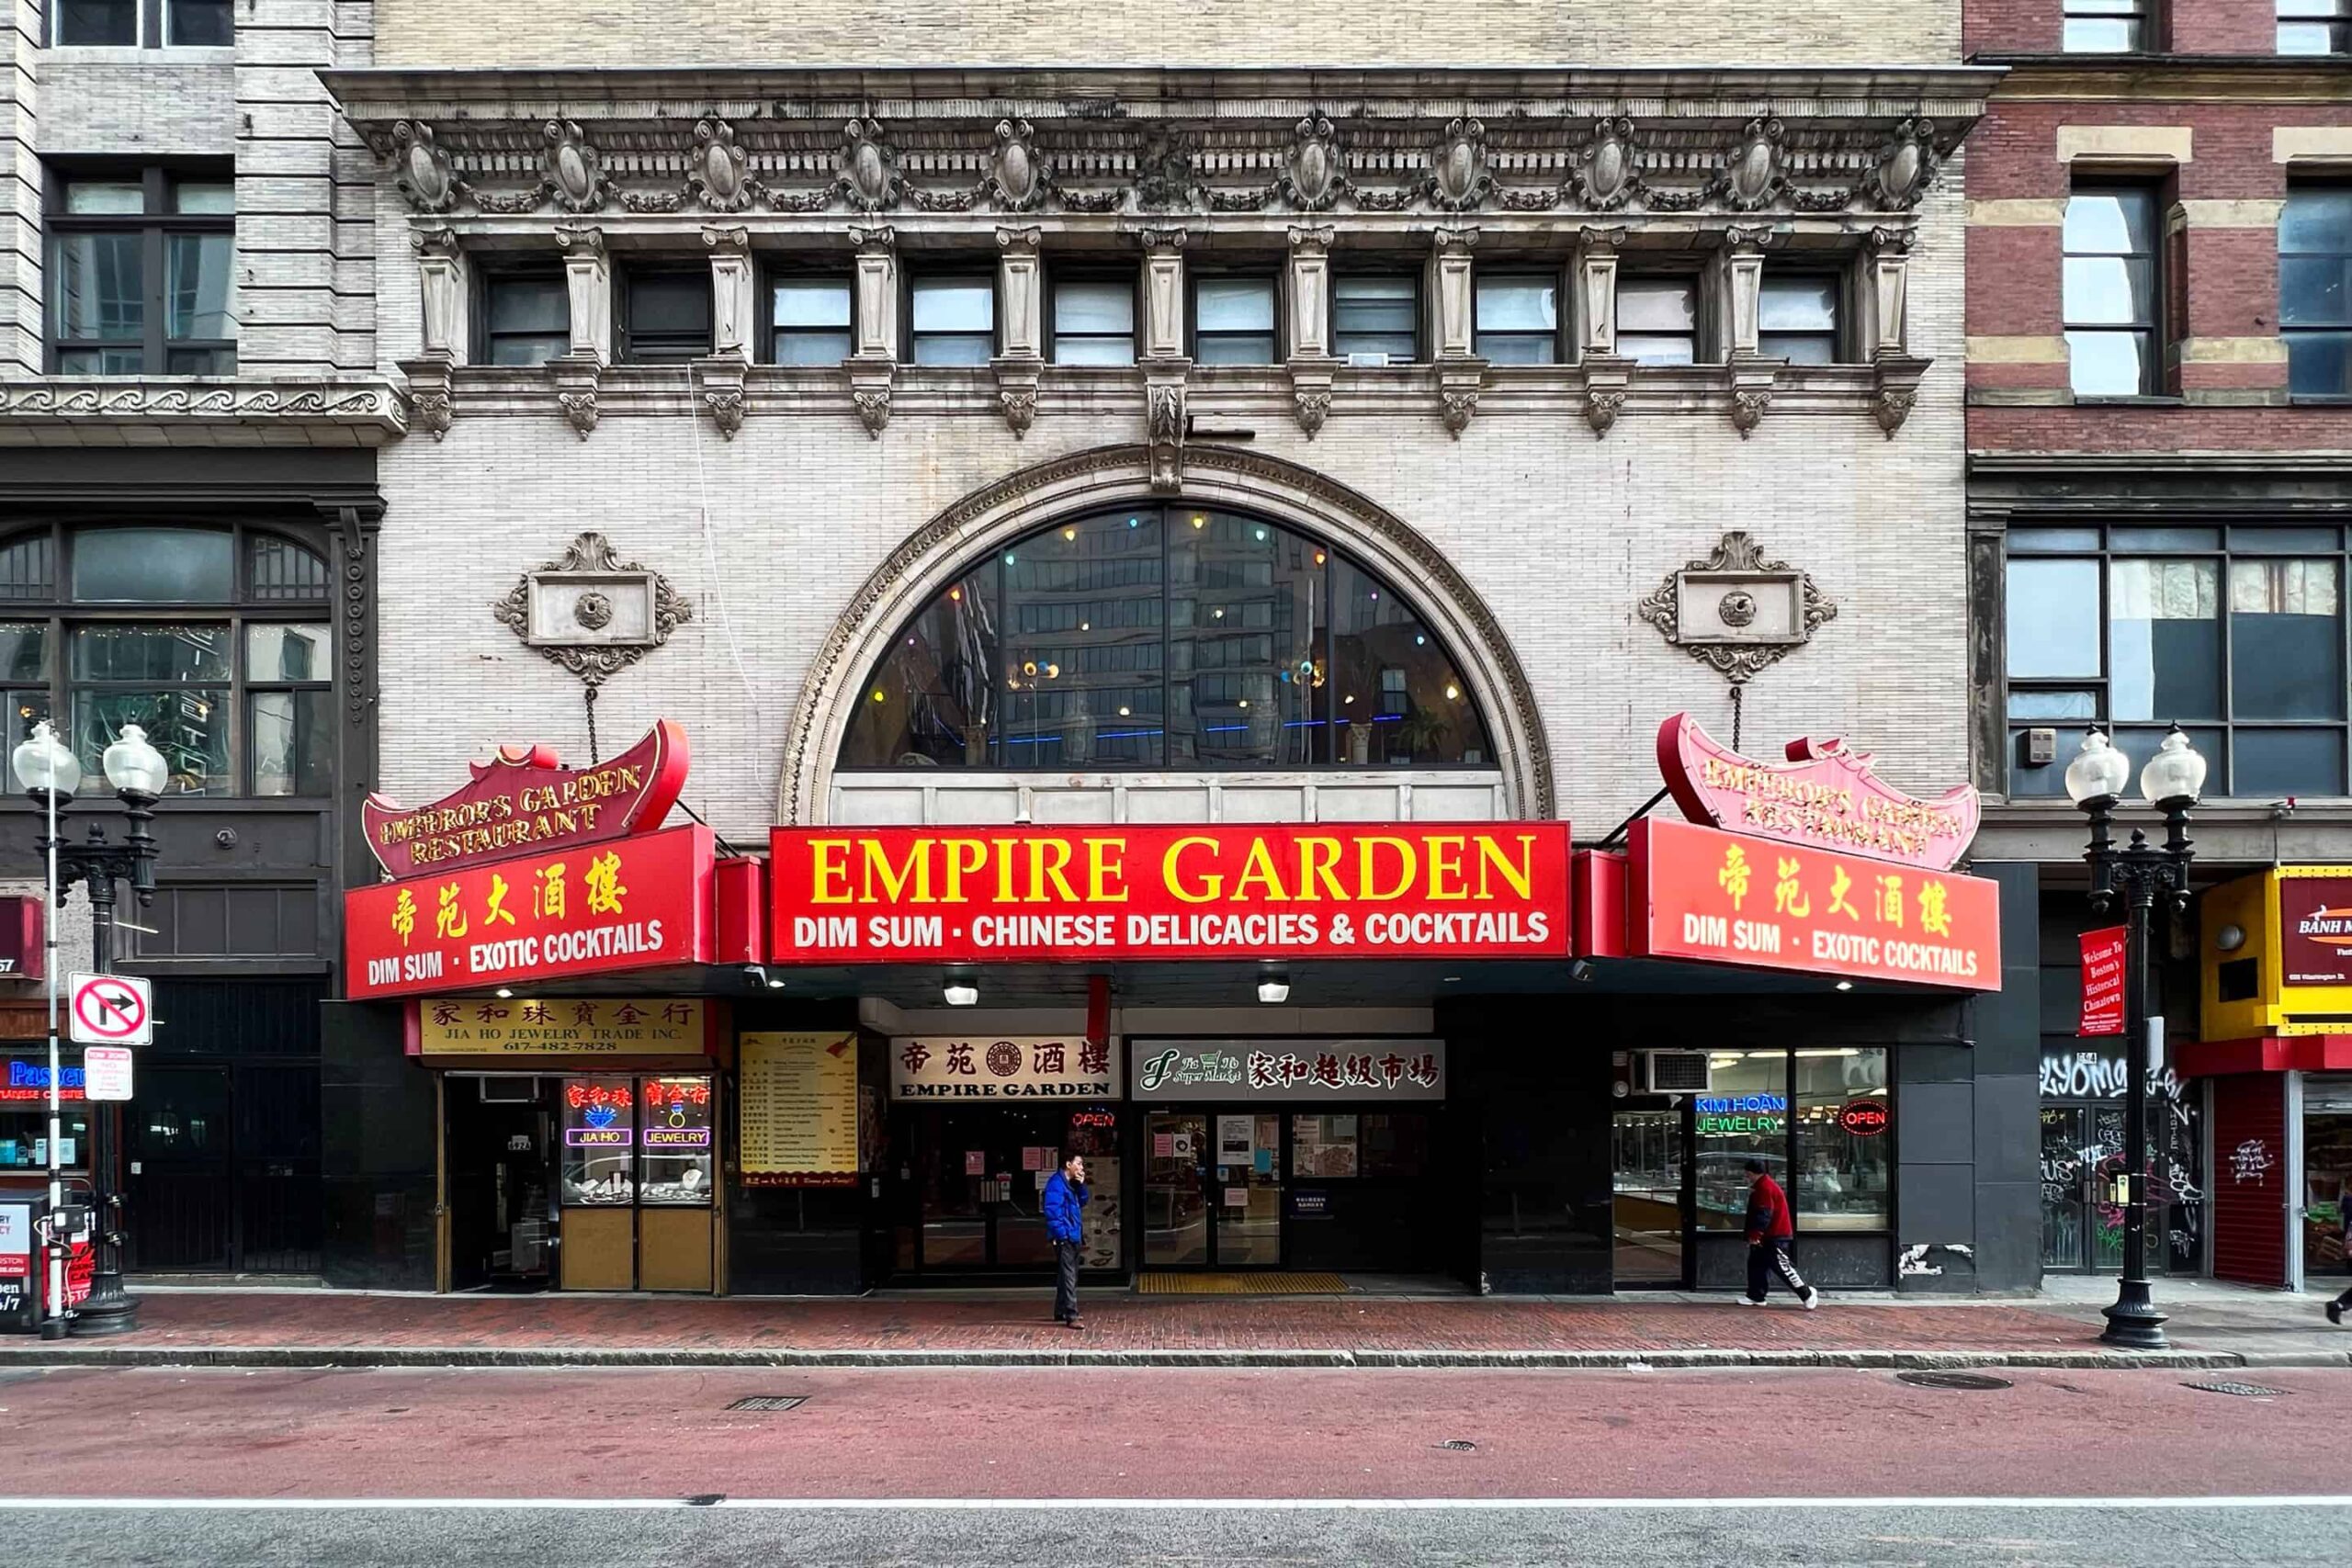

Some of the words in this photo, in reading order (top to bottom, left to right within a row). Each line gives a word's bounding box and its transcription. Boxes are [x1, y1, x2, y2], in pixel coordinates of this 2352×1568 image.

[380, 795, 512, 845] EMPEROR'S
[519, 765, 642, 813] GARDEN
[411, 803, 602, 864] RESTAURANT
[807, 838, 1129, 904] EMPIRE
[1162, 835, 1537, 904] GARDEN
[391, 851, 629, 947] 帝苑大酒樓
[1718, 843, 1952, 939] 帝苑大酒樓
[794, 916, 857, 948] DIM
[868, 916, 943, 948] SUM
[971, 915, 1115, 947] CHINESE
[1126, 913, 1319, 947] DELICACIES
[1329, 912, 1355, 945] &
[1364, 911, 1550, 945] COCKTAILS
[368, 956, 400, 987] DIM
[404, 951, 443, 982] SUM
[469, 937, 538, 974] EXOTIC
[543, 919, 664, 964] COCKTAILS
[1683, 913, 1727, 948] DIM
[1733, 919, 1781, 953] SUM
[1812, 930, 1880, 965] EXOTIC
[1884, 940, 1978, 976] COCKTAILS
[2083, 947, 2113, 965] Welcome
[2113, 941, 2122, 953] To
[2090, 959, 2120, 979] Boston's
[2086, 973, 2120, 997] Historical
[2084, 993, 2121, 1012] Chinatown
[445, 1029, 470, 1040] JIA
[480, 1029, 502, 1040] HO
[509, 1029, 581, 1040] JEWELRY
[590, 1029, 643, 1040] TRADE
[652, 1029, 682, 1040] INC.
[503, 1042, 617, 1051] 617-482-7828
[900, 1041, 977, 1076] 帝苑
[1033, 1041, 1111, 1075] 酒樓
[900, 1084, 998, 1097] EMPIRE
[1002, 1082, 1111, 1096] GARDEN
[1696, 1097, 1728, 1112] KIM
[1072, 1112, 1115, 1126] OPEN
[1697, 1117, 1779, 1132] JEWELRY
[1846, 1111, 1886, 1125] OPEN
[580, 1132, 598, 1143] JIA
[601, 1132, 620, 1143] HO
[647, 1132, 707, 1143] JEWELRY
